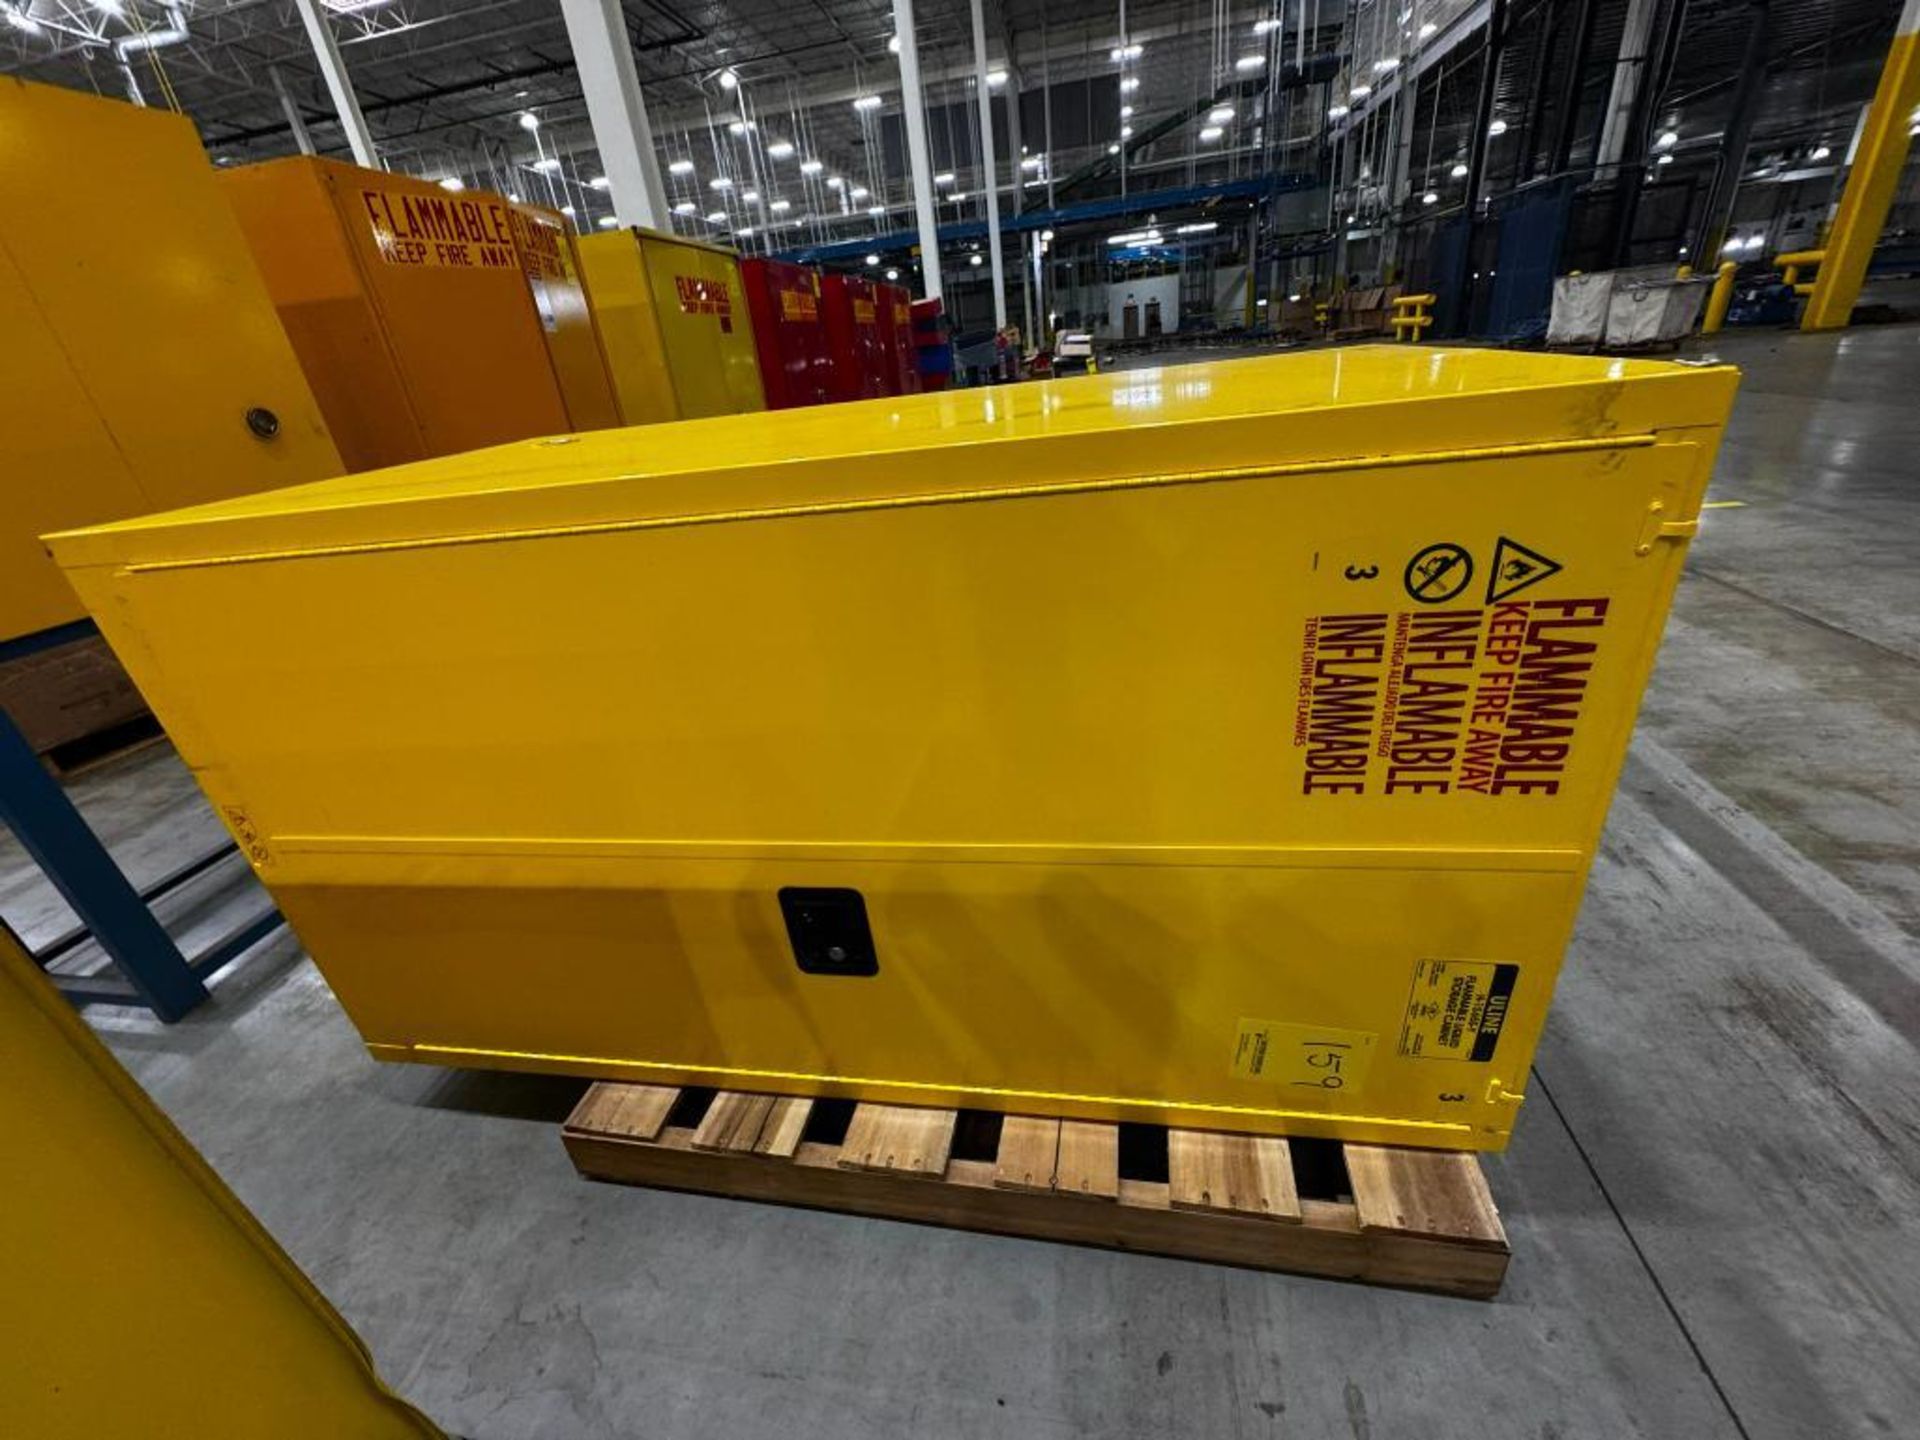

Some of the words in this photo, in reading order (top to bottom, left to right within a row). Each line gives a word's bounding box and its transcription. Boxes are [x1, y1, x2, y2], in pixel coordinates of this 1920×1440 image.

[361, 190, 510, 245] FLAMMABLE
[385, 241, 428, 265] KEEP
[437, 244, 474, 267] FIRE
[480, 247, 517, 269] AWAY
[682, 301, 698, 314] EEP
[1344, 565, 1379, 581] 3
[1302, 616, 1319, 651] TENIR
[1388, 612, 1412, 668] MANTENGA
[1484, 601, 1532, 666] KEEP
[1300, 651, 1315, 676] LOIN
[1298, 677, 1312, 698] DES
[1303, 613, 1389, 795] INFLAMMABLE
[1384, 669, 1401, 710] ALEJADO
[1384, 609, 1483, 795] INFLAMABLE
[1470, 672, 1514, 724] FIRE
[1490, 597, 1611, 796] FLAMMABLE
[1294, 699, 1310, 748] FLAMMES
[1381, 710, 1395, 728] DEL
[1377, 729, 1392, 759] FUEGO
[1457, 729, 1499, 794] AWAY
[1481, 994, 1508, 1035] ULINE
[1290, 1042, 1352, 1089] 159
[1439, 1093, 1465, 1103] 3
